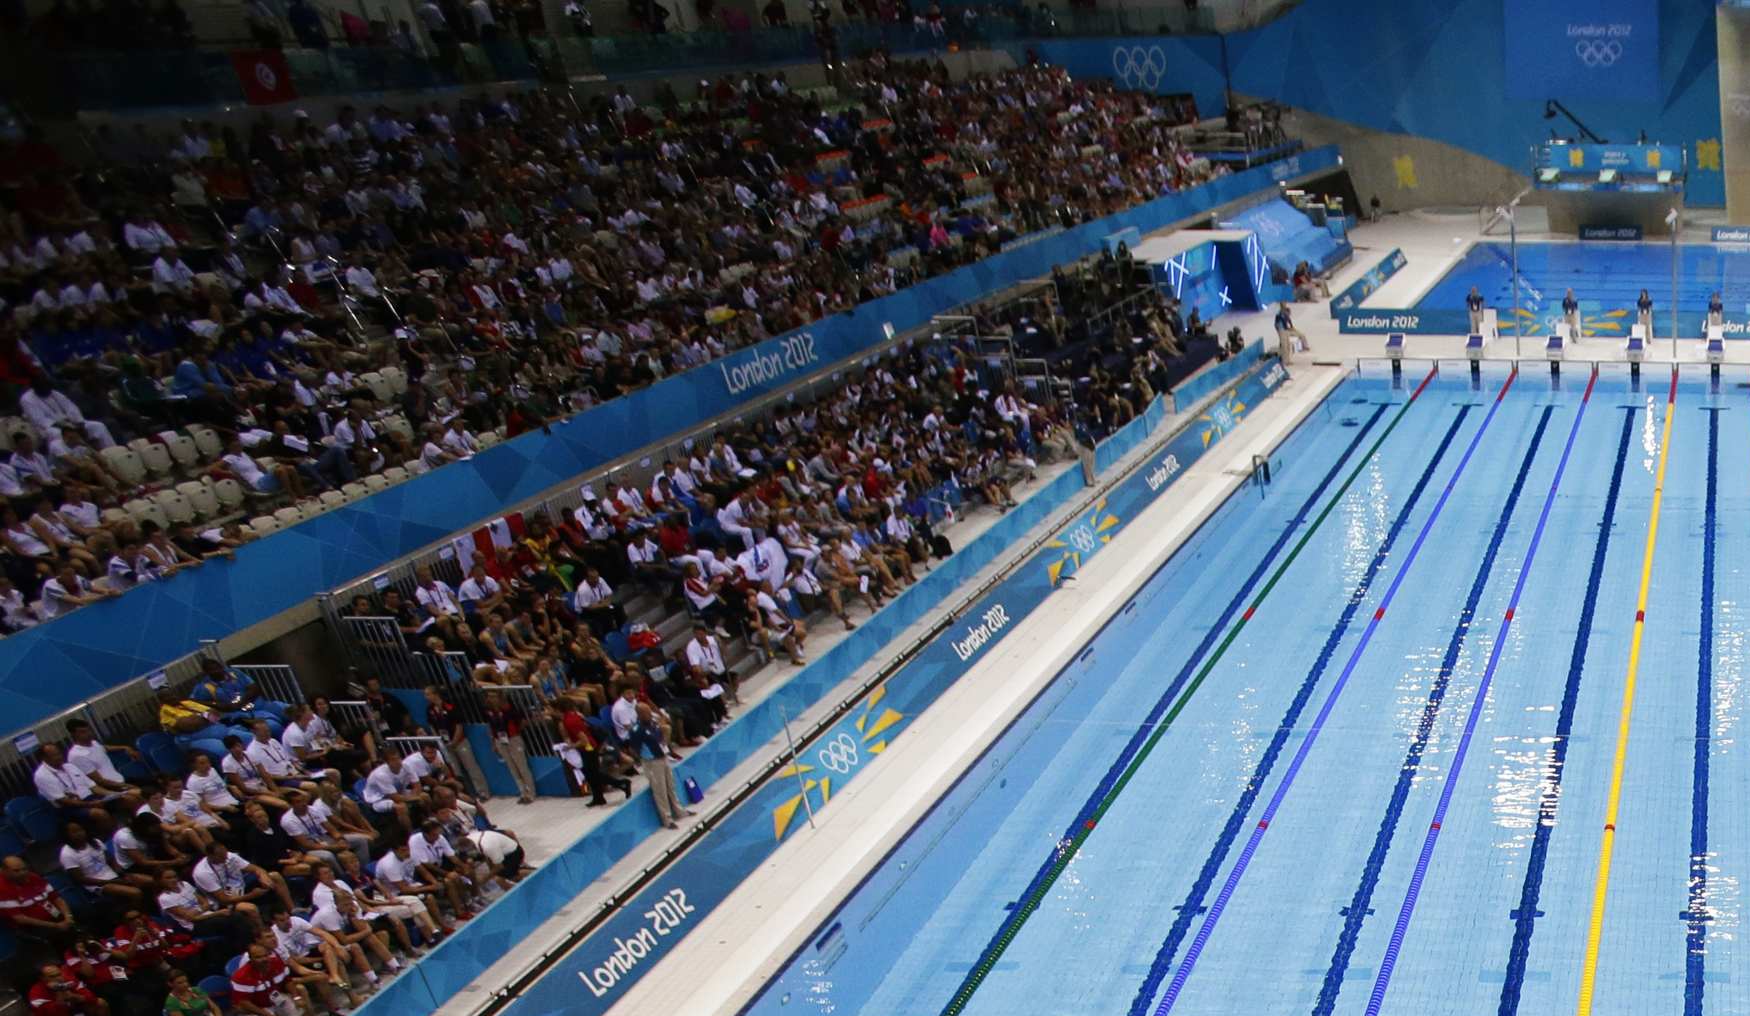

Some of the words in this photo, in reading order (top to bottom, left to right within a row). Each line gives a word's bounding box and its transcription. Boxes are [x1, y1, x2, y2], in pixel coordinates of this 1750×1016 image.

[1567, 24, 1605, 36] London
[1717, 230, 1748, 240] London
[1347, 315, 1390, 328] London
[1391, 315, 1419, 328] 2012
[1701, 320, 1744, 333] Ldon
[721, 347, 784, 395] London
[779, 332, 819, 369] 2012
[951, 624, 992, 661] London
[982, 604, 1011, 632] 2012
[578, 929, 658, 997] London
[643, 888, 695, 936] 2012
